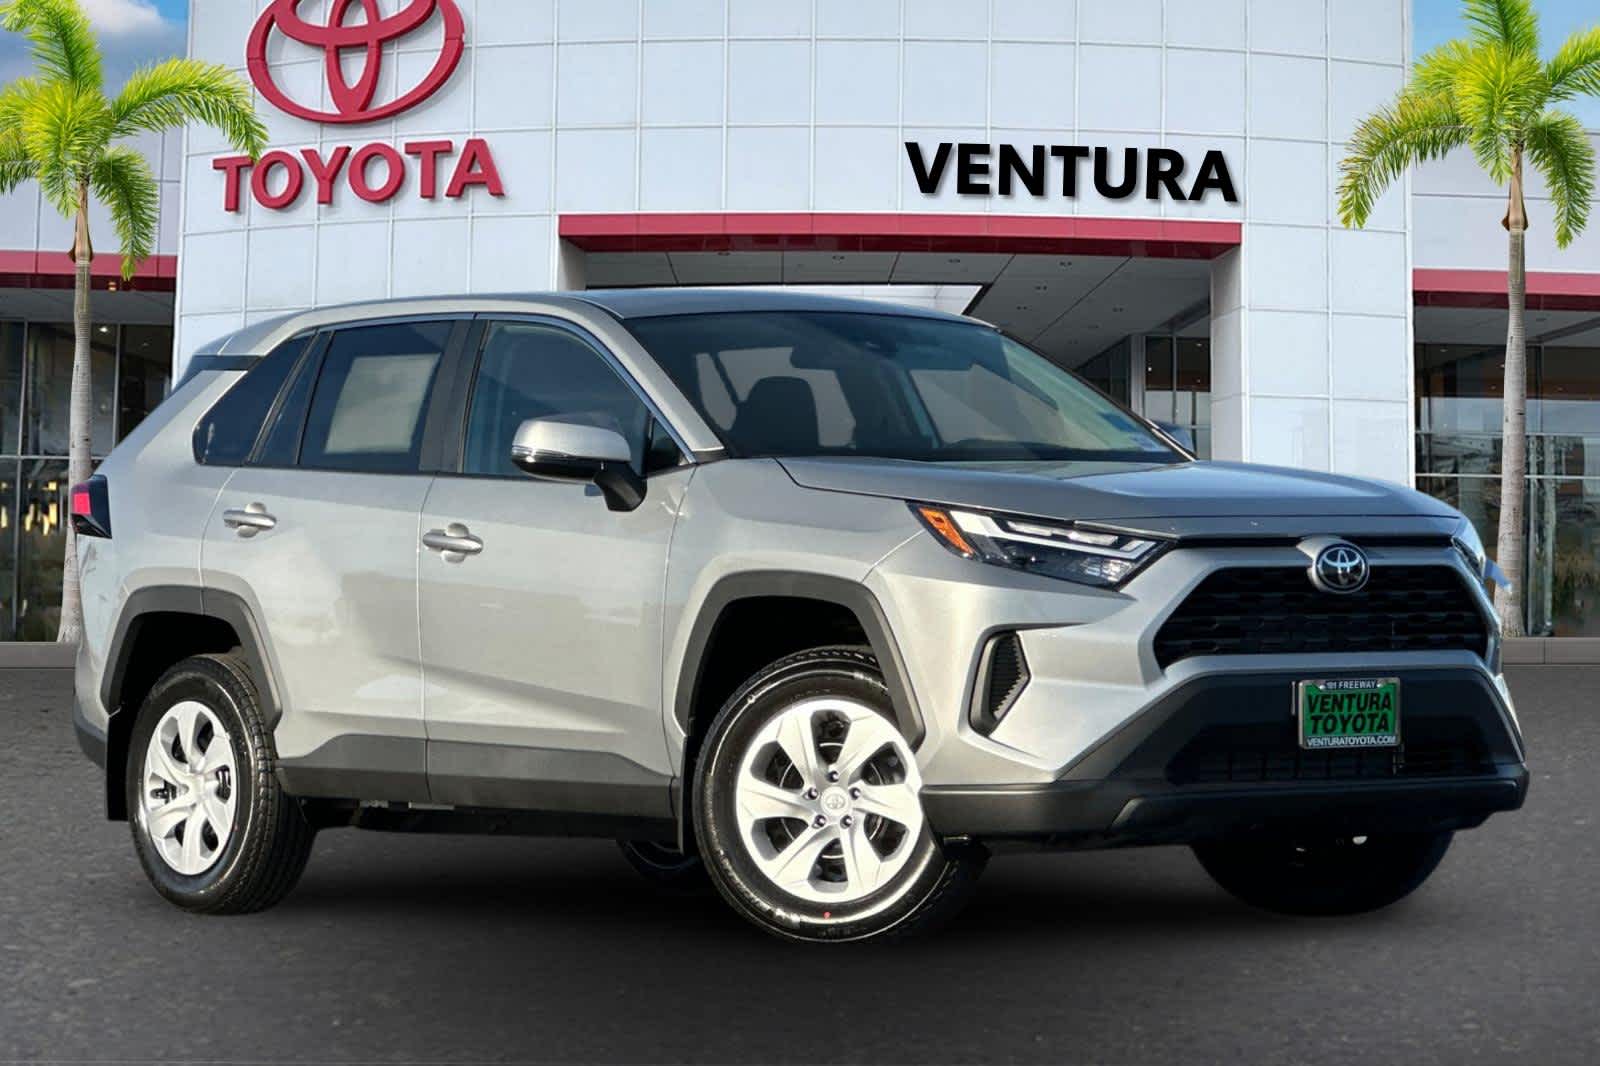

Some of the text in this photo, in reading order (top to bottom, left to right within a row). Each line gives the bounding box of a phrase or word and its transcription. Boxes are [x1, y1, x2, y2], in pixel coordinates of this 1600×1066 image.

[213, 138, 505, 212] TOYOTA
[904, 142, 1239, 202] VENTURA
[1338, 680, 1377, 689] FREEWAY
[1307, 692, 1392, 713] VENTURA
[1310, 713, 1390, 734] TOYOTA
[1306, 735, 1396, 747] VENTURATOYOTA.COM
